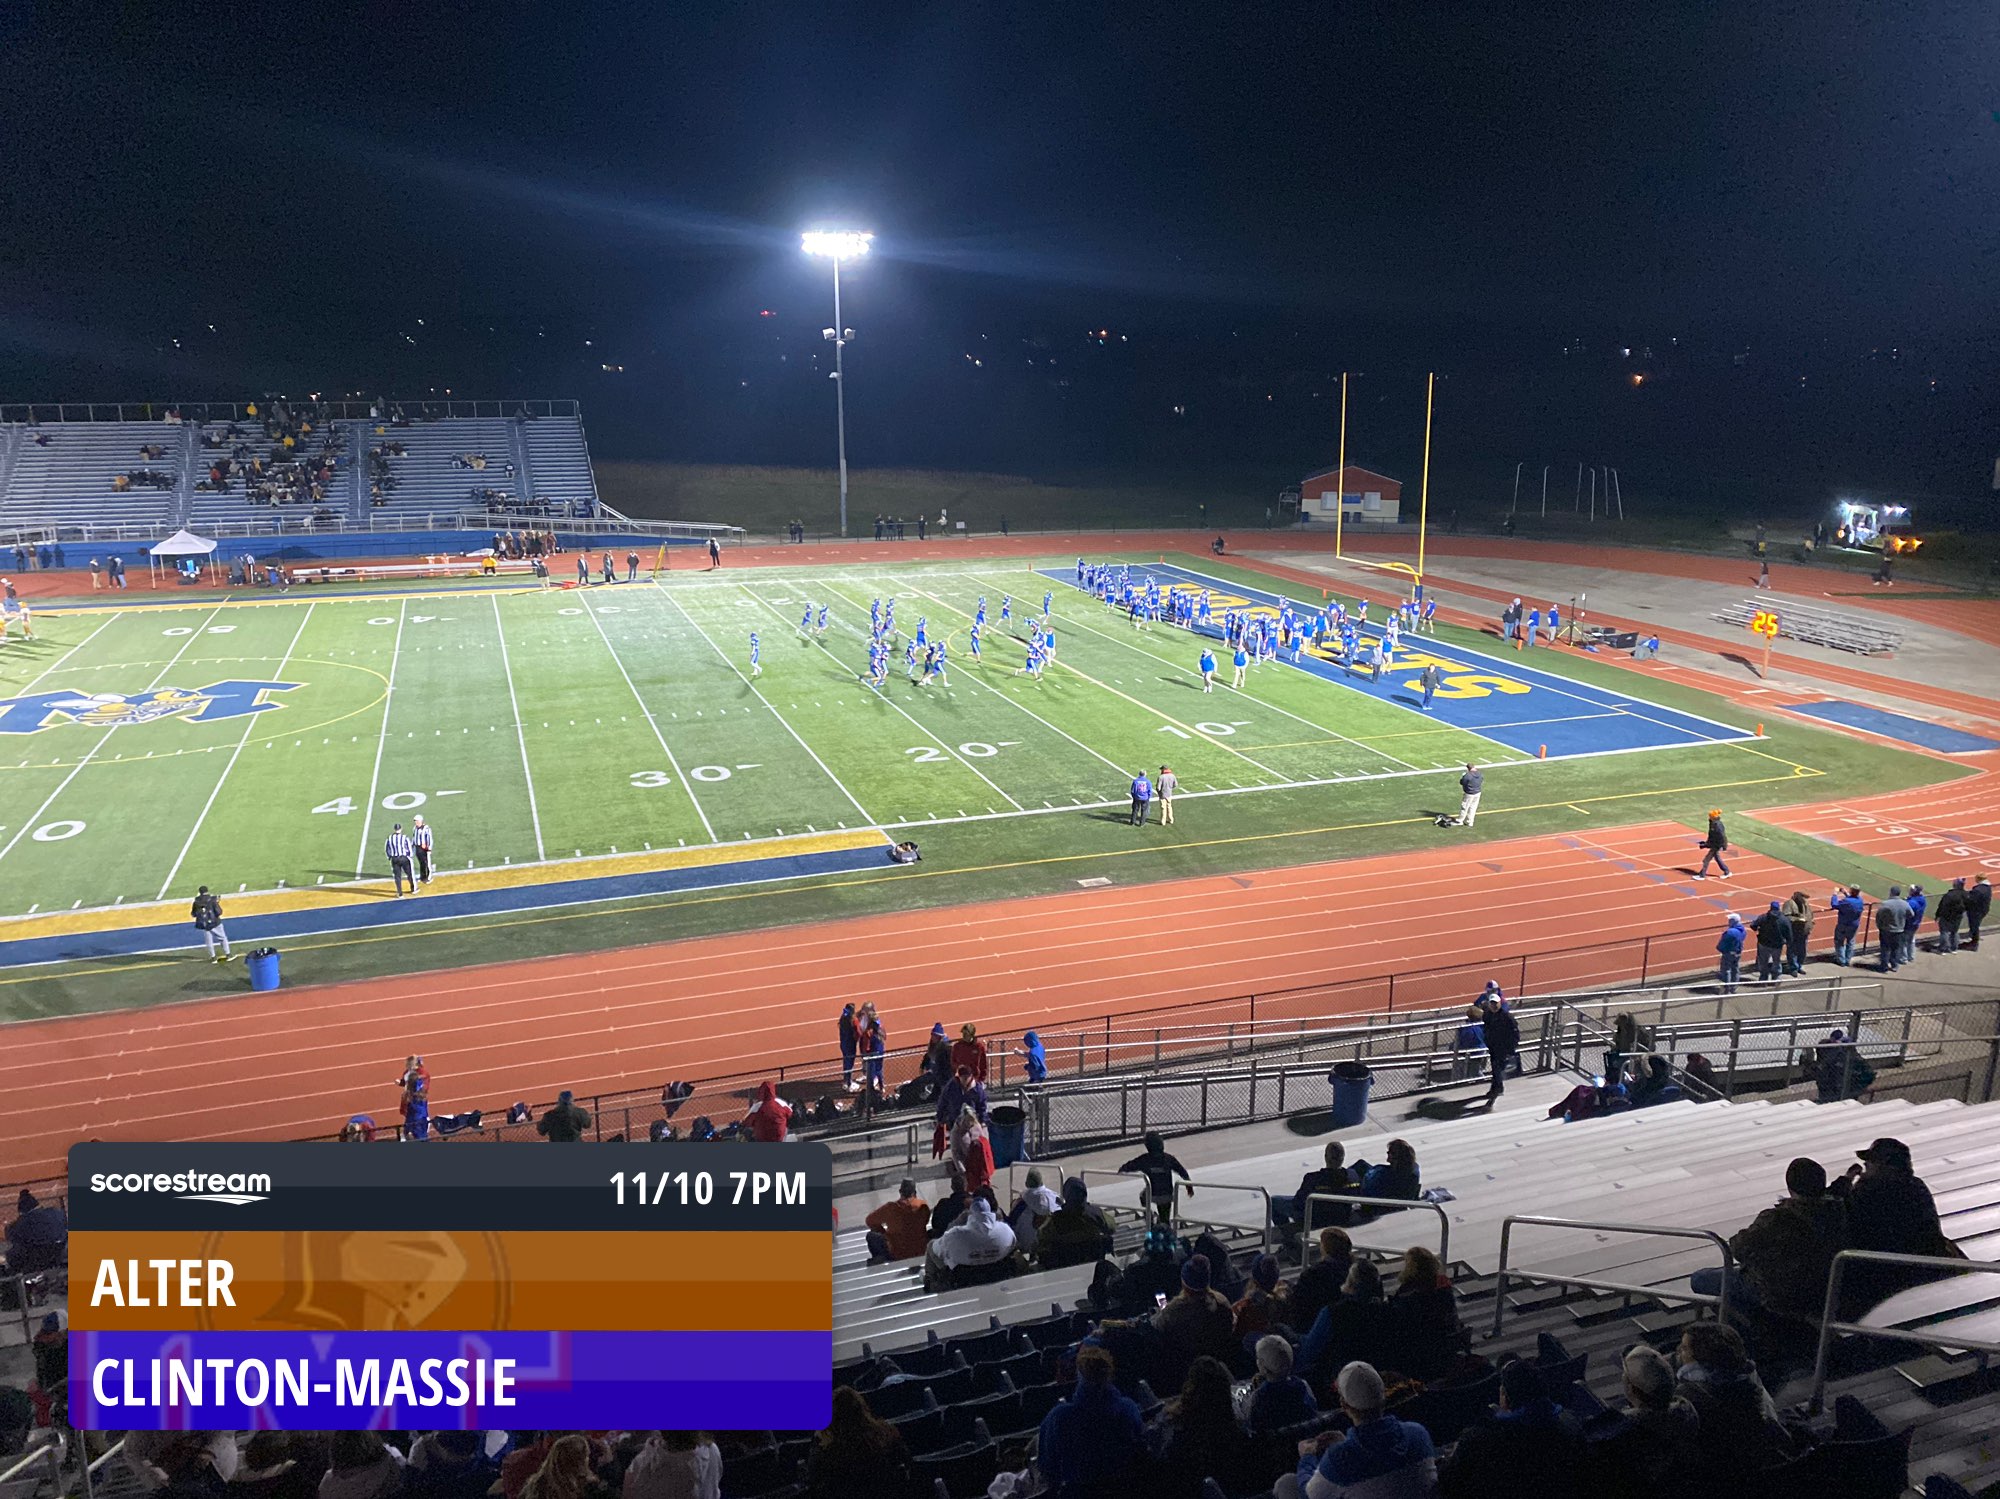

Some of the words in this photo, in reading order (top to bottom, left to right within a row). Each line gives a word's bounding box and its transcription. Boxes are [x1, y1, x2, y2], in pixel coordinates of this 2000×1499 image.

[1752, 611, 1778, 636] 25
[1157, 721, 1237, 740] 10
[904, 741, 999, 763] 20
[629, 765, 732, 788] 30
[311, 790, 428, 816] 40
[1839, 816, 1877, 826] 2
[1875, 825, 1910, 835] 3
[1911, 836, 1945, 846] 4
[1943, 846, 1984, 857] 5
